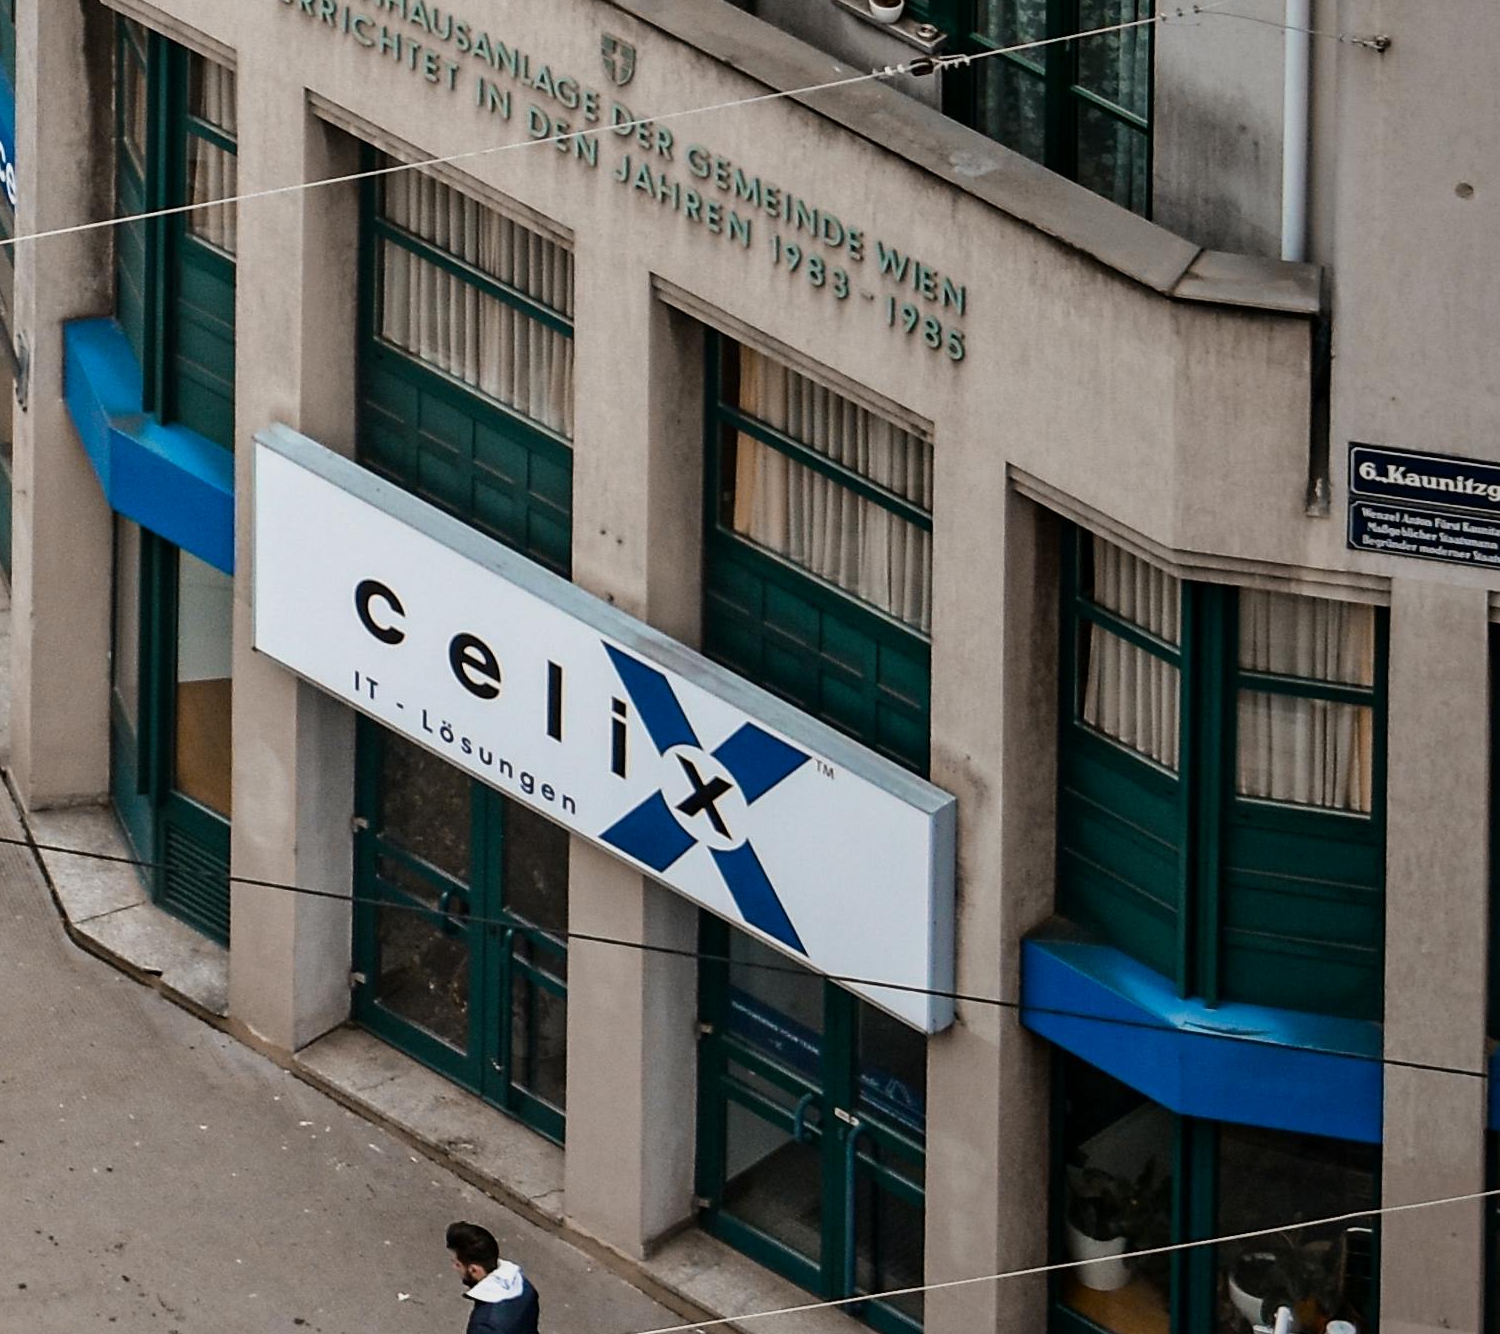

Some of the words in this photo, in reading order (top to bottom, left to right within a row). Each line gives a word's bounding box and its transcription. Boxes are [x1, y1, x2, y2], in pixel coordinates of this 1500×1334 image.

[475, 76, 511, 121] IN
[526, 104, 599, 168] DEN
[614, 154, 753, 249] JAHREN
[770, 234, 850, 301] 1983
[885, 293, 966, 362] 1985
[611, 99, 675, 162] DER
[685, 142, 865, 262] GEMEINDE
[875, 240, 967, 317] WIEN
[354, 578, 737, 841] celix
[354, 670, 380, 700] IT
[421, 708, 577, 816] Lösungen
